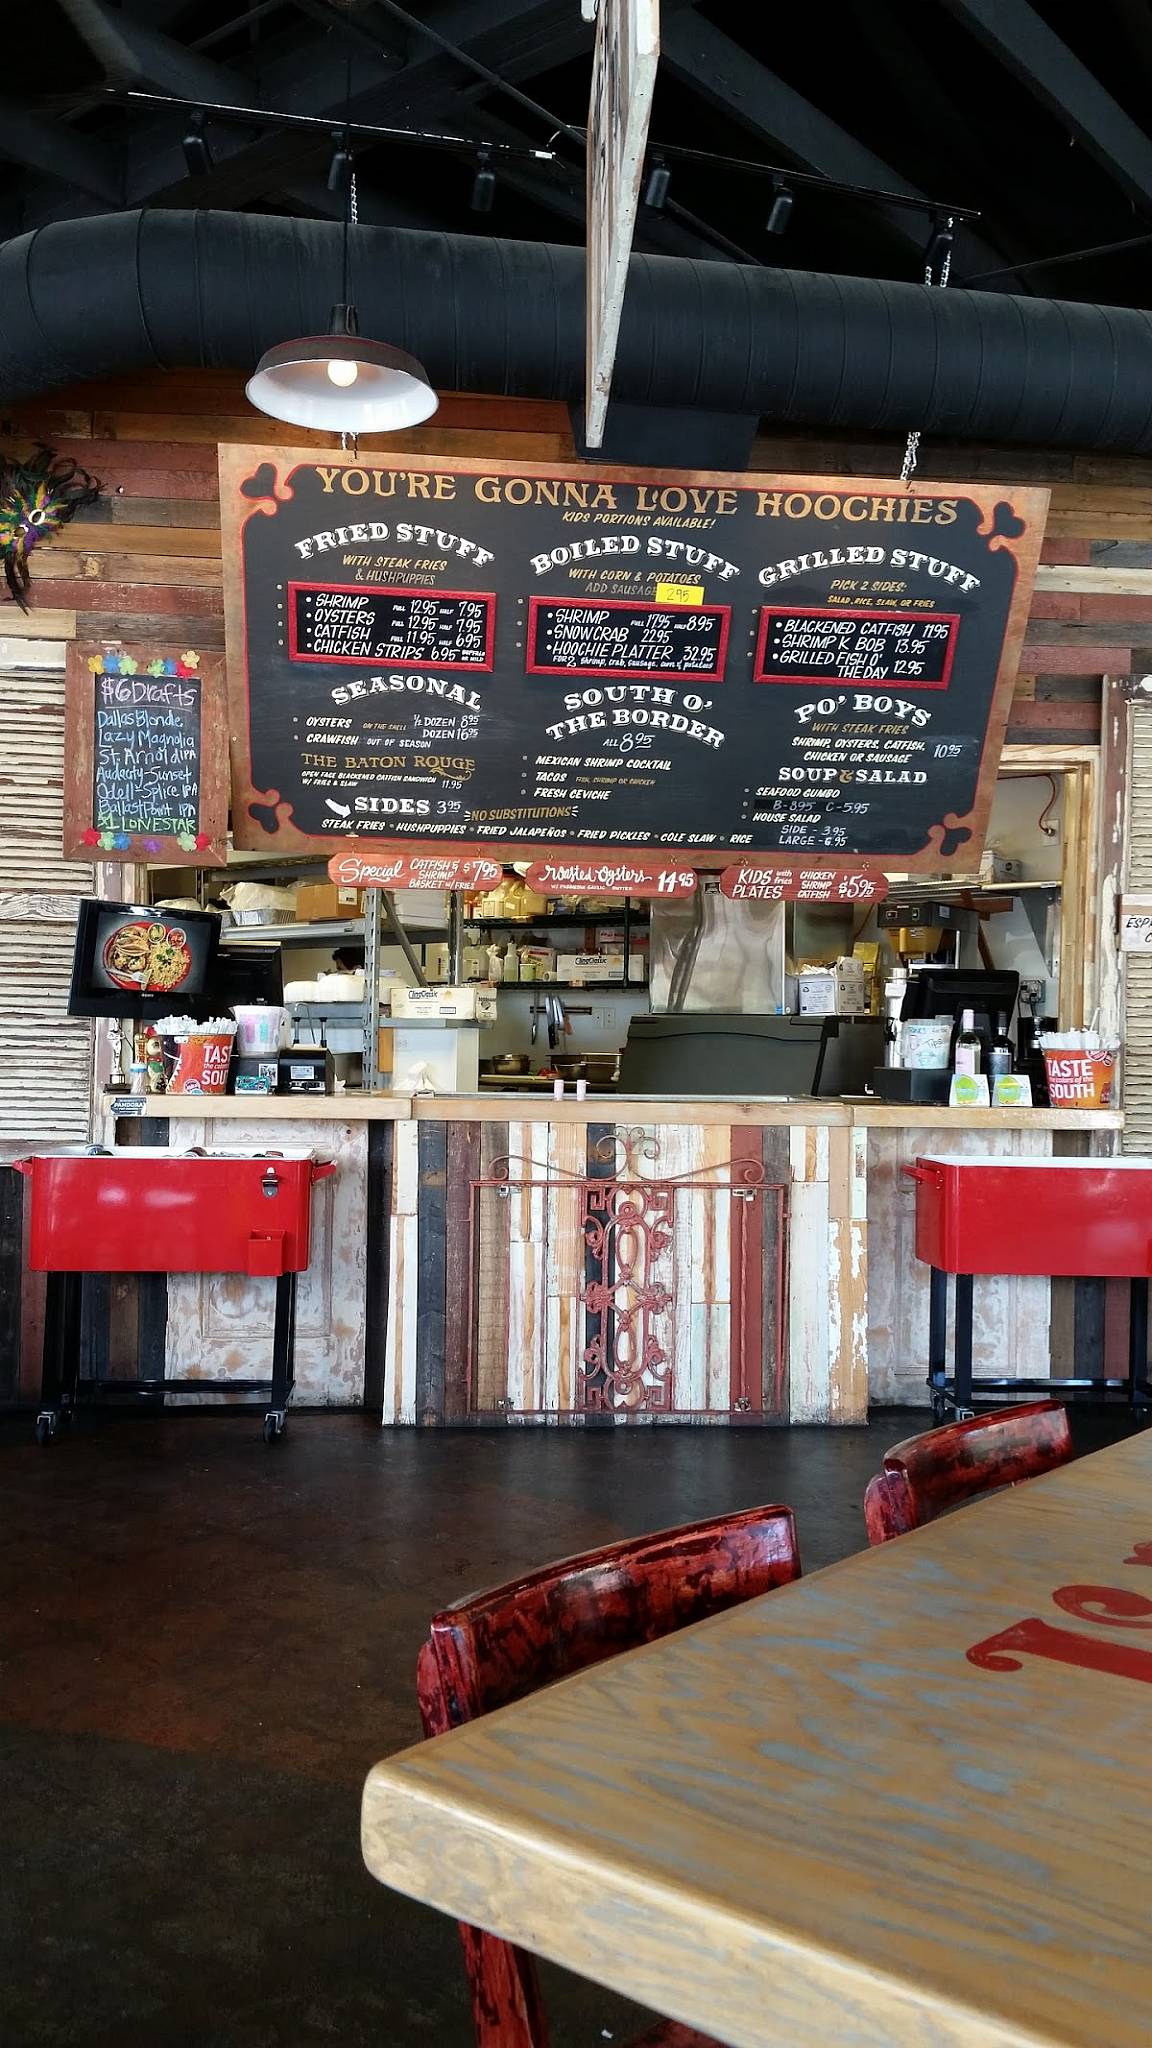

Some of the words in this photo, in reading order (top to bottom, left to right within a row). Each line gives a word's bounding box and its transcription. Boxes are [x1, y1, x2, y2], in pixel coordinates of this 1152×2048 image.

[315, 466, 457, 500] YOU'RE
[474, 476, 617, 509] GONNA
[756, 492, 958, 525] HOOCHIES
[562, 511, 593, 523] KIDS
[594, 513, 651, 527] PORTIONS
[653, 516, 716, 531] AVAILABLE!
[294, 522, 391, 559] FRIED
[396, 523, 495, 567] STUFF
[342, 554, 371, 567] WITH
[374, 556, 409, 569] STEAK
[414, 558, 448, 571] FRIES
[530, 535, 641, 576] BOILED
[646, 536, 741, 582] STUFF
[355, 568, 363, 581] &
[366, 570, 436, 586] HUSHPUPPIES
[568, 568, 596, 580] WITH
[599, 569, 631, 582] CORN
[634, 570, 642, 582] &
[646, 571, 702, 585] POTATOES
[758, 546, 886, 588] GRILLED
[890, 548, 981, 594] STUFF
[585, 582, 607, 594] ADD
[830, 579, 857, 591] PICK
[859, 580, 869, 591] 2
[315, 593, 370, 610] SHRIMP
[314, 608, 375, 625] OYSTERS
[555, 608, 610, 625] SHRIMP
[314, 624, 371, 640] CATFISH
[784, 619, 856, 636] BLACKENED
[860, 622, 915, 638] CATFISH
[313, 639, 372, 656] CHICKEN
[374, 643, 424, 660] STRIPS
[552, 642, 613, 658] HOOCHIE
[612, 644, 674, 661] PLATTER
[781, 634, 837, 650] SHRIMP
[838, 636, 849, 651] K
[855, 637, 886, 653] BOB
[779, 650, 835, 666] GRILLED
[836, 652, 867, 666] FISH
[837, 665, 864, 680] THE
[864, 666, 889, 680] DAY
[331, 675, 482, 712] SEASONAL
[564, 684, 679, 711] SOUTH
[682, 693, 713, 713] O'
[794, 695, 847, 724] PO'
[852, 693, 932, 728] BOYS
[306, 716, 352, 729] OYSTERS
[423, 717, 456, 727] DOZEN
[545, 711, 607, 742] THE
[612, 708, 726, 750] BORDER
[811, 722, 839, 733] WITH
[841, 723, 879, 735] STEAK
[880, 724, 910, 736] FRIES
[99, 728, 136, 751] Lazy
[138, 730, 195, 749] Magnolia
[305, 733, 359, 746] CRAWFISH
[366, 737, 382, 746] OUT
[384, 738, 395, 747] OF
[399, 739, 432, 749] SEASON
[422, 729, 455, 739] DOZEN
[602, 737, 619, 748] ALL
[301, 753, 337, 768] THE
[344, 755, 407, 769] BATON
[413, 755, 476, 771] ROUGE
[535, 755, 582, 767] MEXICAN
[583, 757, 624, 769] SHRIMP
[625, 759, 673, 771] COCKTAIL
[803, 750, 848, 763] CHICKEN
[849, 752, 864, 763] OR
[866, 752, 913, 764] SAUSAGE
[535, 771, 568, 782] TACOS
[778, 767, 838, 782] SOUP
[838, 768, 854, 785] &
[854, 769, 929, 785] SALAD
[182, 783, 198, 798] IPA
[533, 787, 568, 799] FRESH
[569, 788, 612, 801] CEVICHE
[755, 786, 801, 799] SEAFOOD
[802, 787, 841, 800] GUMBO
[178, 803, 197, 817] IPA
[354, 796, 431, 815] SIDES
[470, 809, 487, 821] NO
[488, 806, 571, 820] SUBSTITUTIONS
[752, 812, 787, 823] HOUSE
[788, 813, 822, 824] SALAD
[321, 818, 354, 830] STEAK
[356, 820, 386, 832] FRIES
[395, 822, 467, 835] HUSHPUPPIES
[476, 825, 506, 836] FRIED
[510, 825, 567, 839] JALAPEÑOS
[577, 828, 607, 840] FRIED
[610, 830, 651, 842] PICKLES
[660, 832, 685, 843] COLE
[687, 832, 717, 844] SLAW
[729, 833, 753, 845] RICE
[780, 824, 808, 835] SIDE
[778, 835, 816, 846] LARGE
[338, 858, 406, 883] Special
[410, 857, 450, 870] CATFISH
[418, 869, 455, 880] SHRIMP
[737, 868, 773, 886] KIDS
[799, 870, 836, 880] CHICKEN
[408, 879, 446, 889] BASKET
[731, 884, 784, 900] PLATES
[801, 880, 833, 890] SHRIMP
[797, 889, 831, 899] CATFISH
[1046, 1059, 1094, 1078] TASTE
[1050, 1083, 1095, 1099] SOUTH
